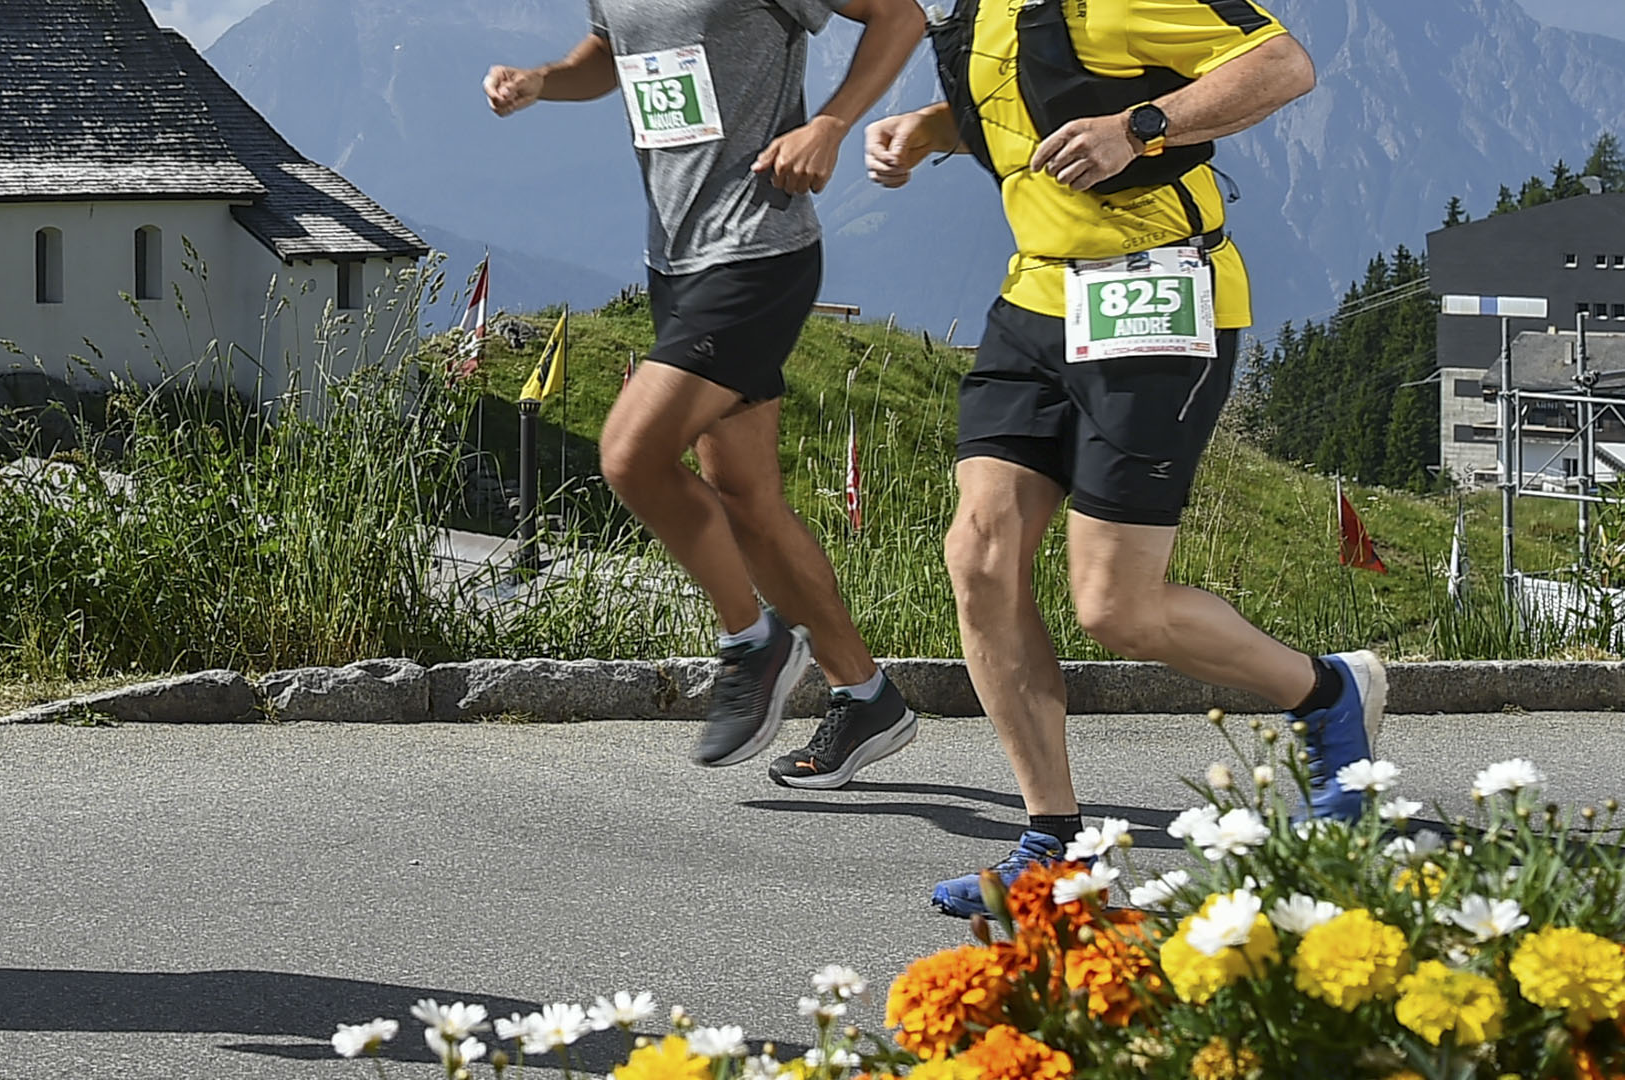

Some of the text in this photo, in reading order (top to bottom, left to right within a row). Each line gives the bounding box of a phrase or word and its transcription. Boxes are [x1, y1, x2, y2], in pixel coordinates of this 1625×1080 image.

[637, 79, 687, 113] 763
[1099, 279, 1182, 317] 825
[1114, 313, 1173, 337] ANDRÉ
